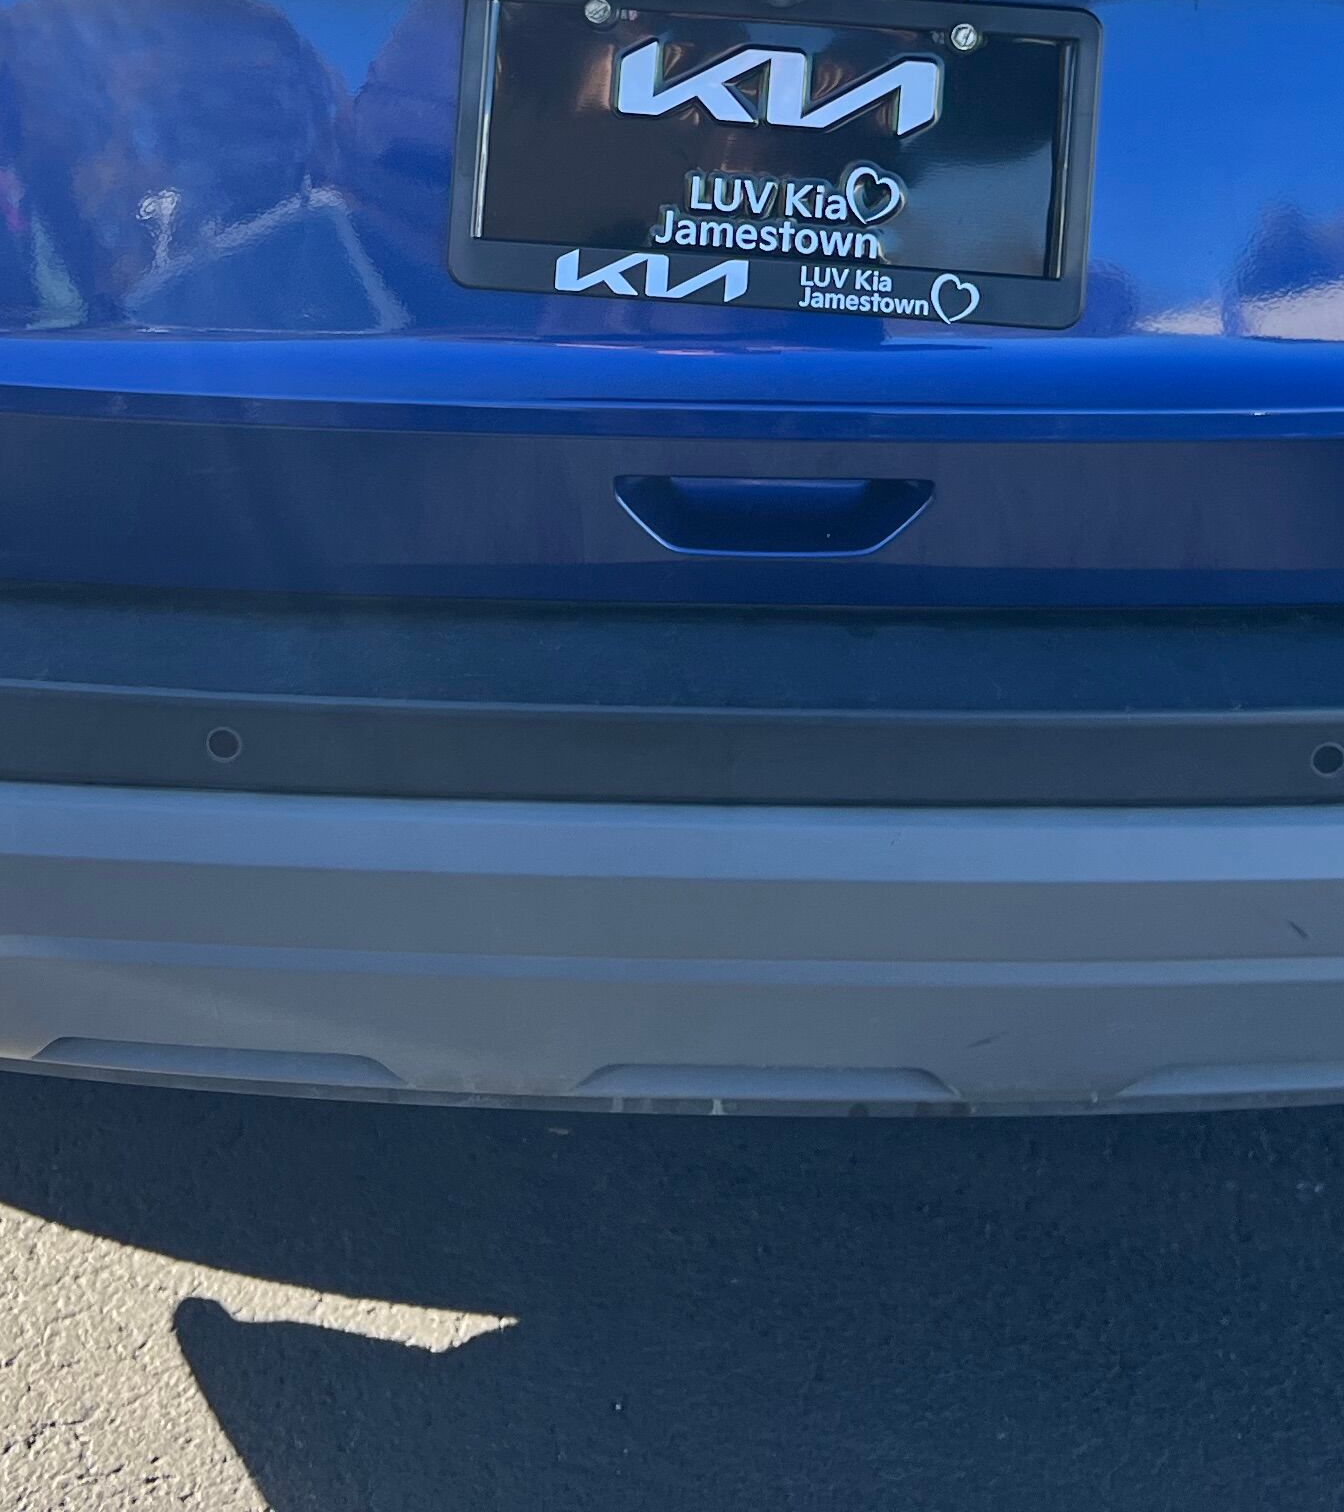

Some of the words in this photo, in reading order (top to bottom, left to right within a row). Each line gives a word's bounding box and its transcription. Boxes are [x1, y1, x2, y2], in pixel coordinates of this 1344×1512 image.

[689, 174, 777, 216] LUV
[784, 181, 849, 222] Kia
[654, 210, 880, 261] Jamestown
[799, 265, 849, 291] LUV
[854, 269, 893, 294] Kia
[798, 288, 930, 317] Jamestown
